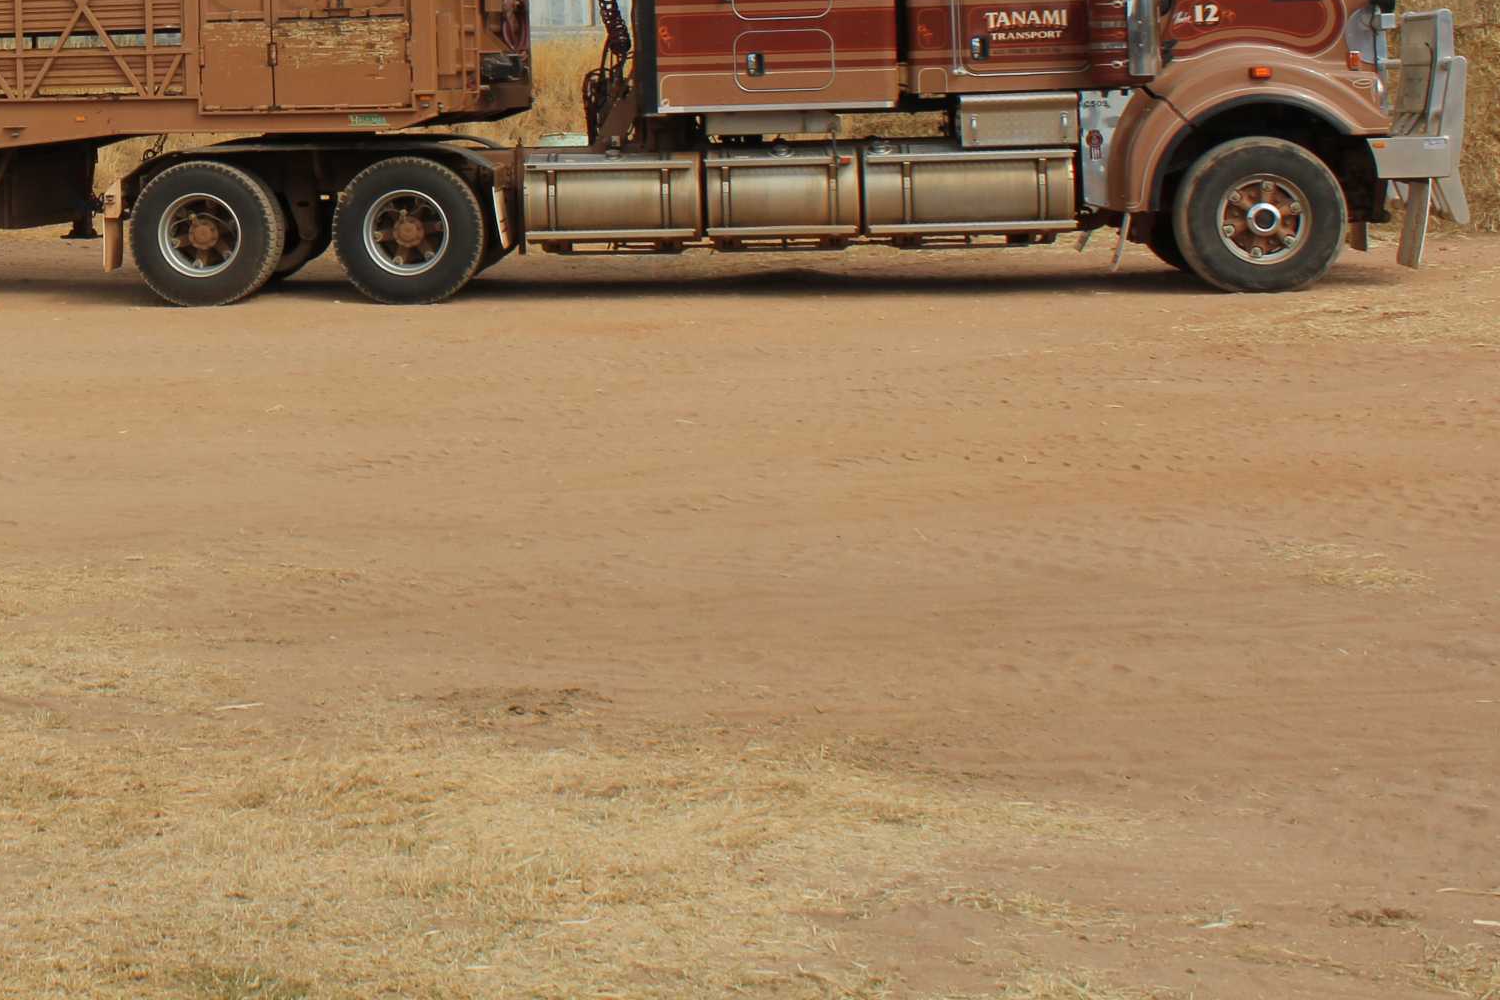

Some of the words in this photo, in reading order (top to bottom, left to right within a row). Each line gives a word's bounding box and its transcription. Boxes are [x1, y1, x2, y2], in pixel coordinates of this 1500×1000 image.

[984, 9, 1068, 31] TANAMI
[1193, 3, 1220, 24] 12
[990, 30, 1062, 40] TRANSPORT
